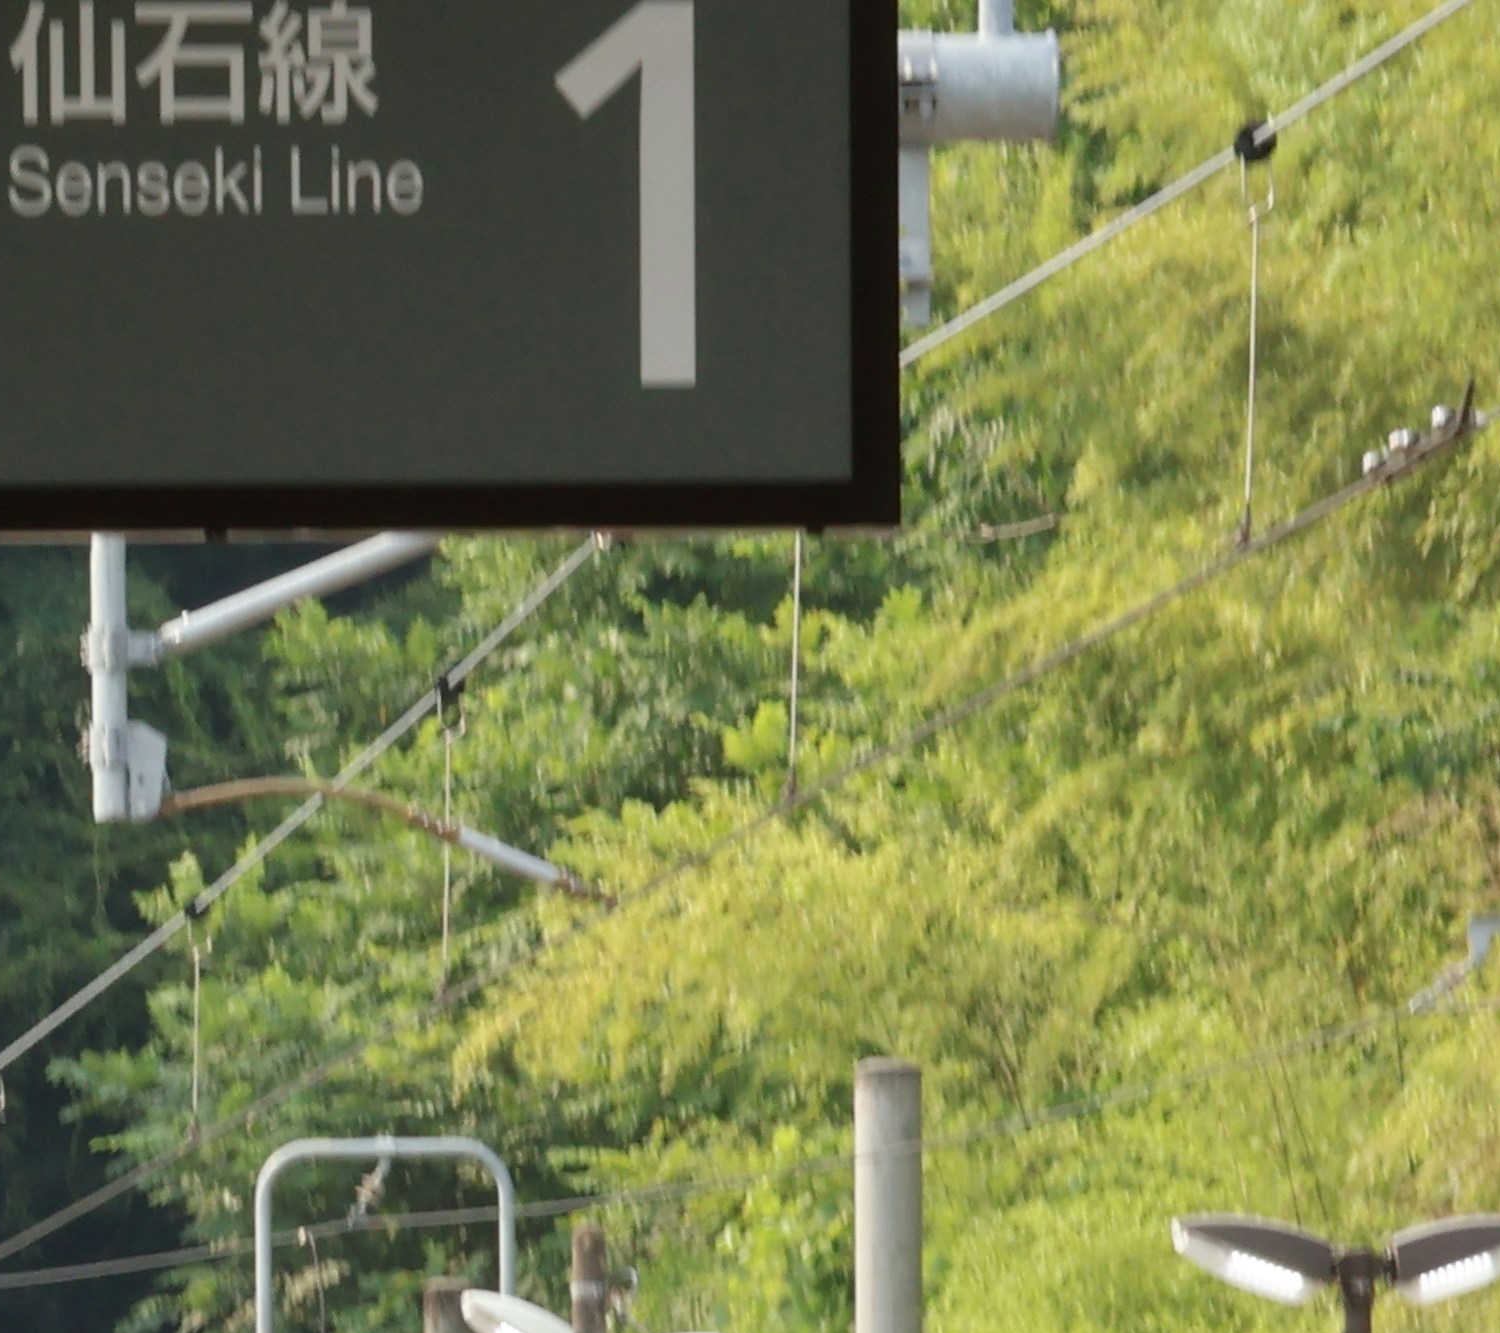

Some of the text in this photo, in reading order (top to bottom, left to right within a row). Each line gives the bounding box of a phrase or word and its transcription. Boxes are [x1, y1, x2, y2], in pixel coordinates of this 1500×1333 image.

[10, 0, 377, 125] 仙石線
[8, 144, 424, 217] Senseki Line
[555, 0, 697, 388] 1
